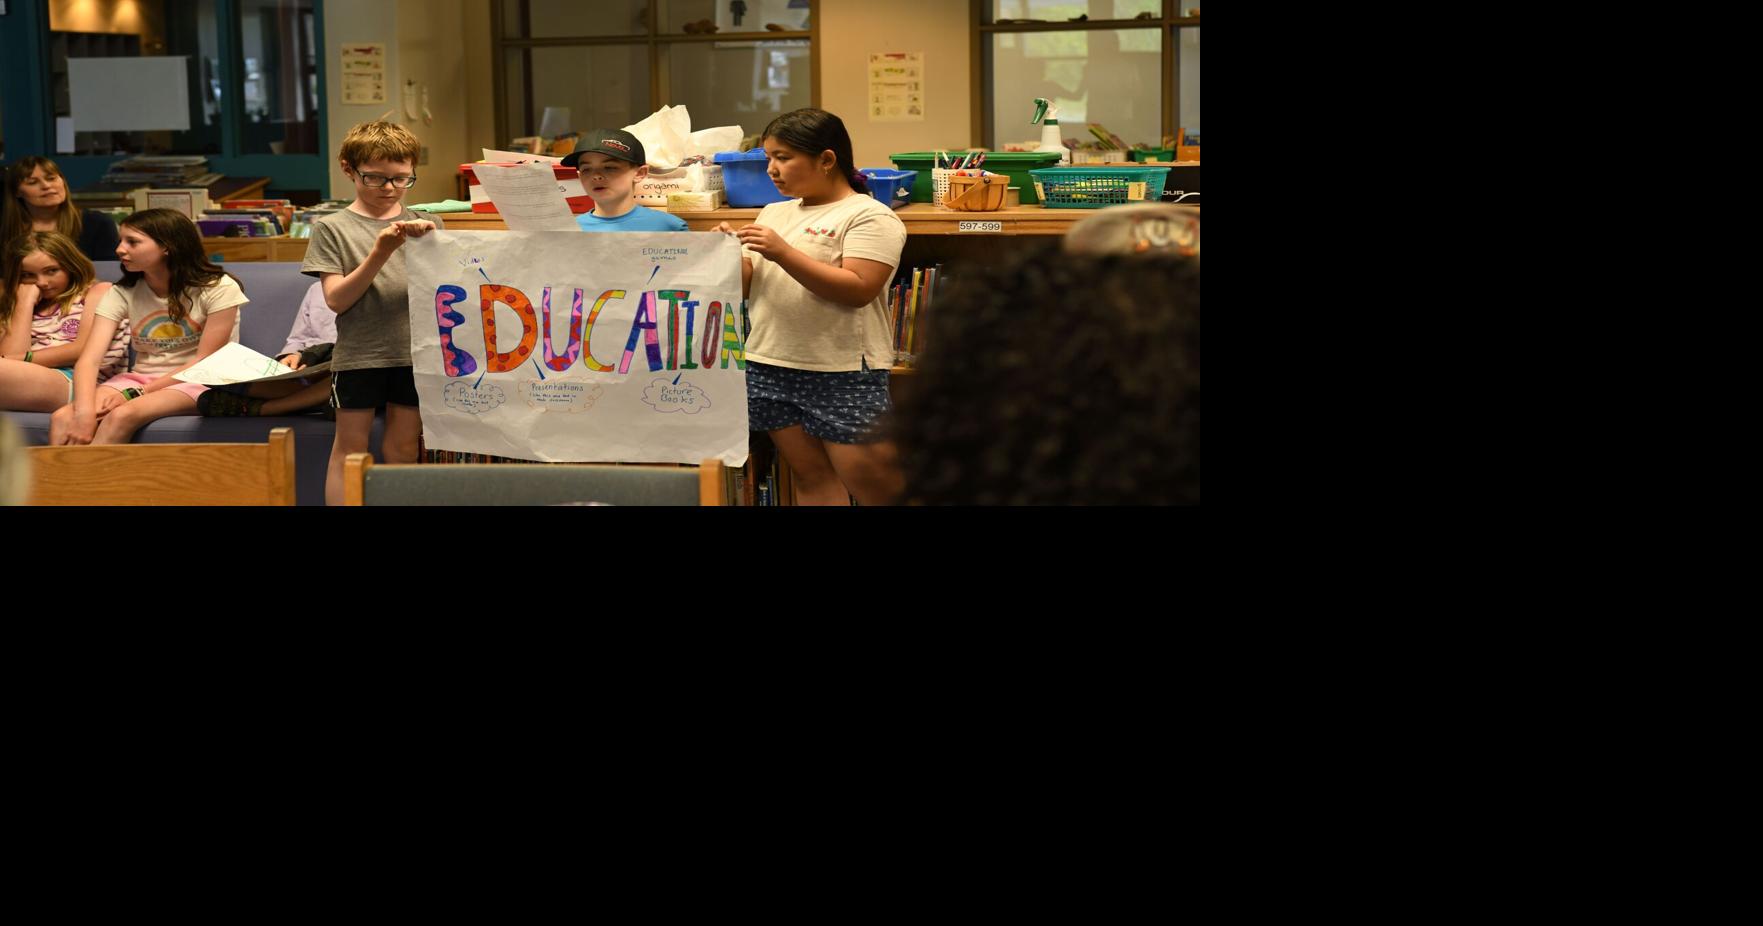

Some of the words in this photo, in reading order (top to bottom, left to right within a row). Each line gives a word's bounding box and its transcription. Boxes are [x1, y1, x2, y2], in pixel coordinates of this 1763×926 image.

[642, 183, 680, 194] origami
[960, 222, 1001, 231] 597-599
[435, 284, 746, 377] EDUCATION
[531, 382, 584, 392] Presentations
[661, 386, 693, 396] Picture
[459, 387, 494, 400] Posters
[660, 394, 695, 405] Books
